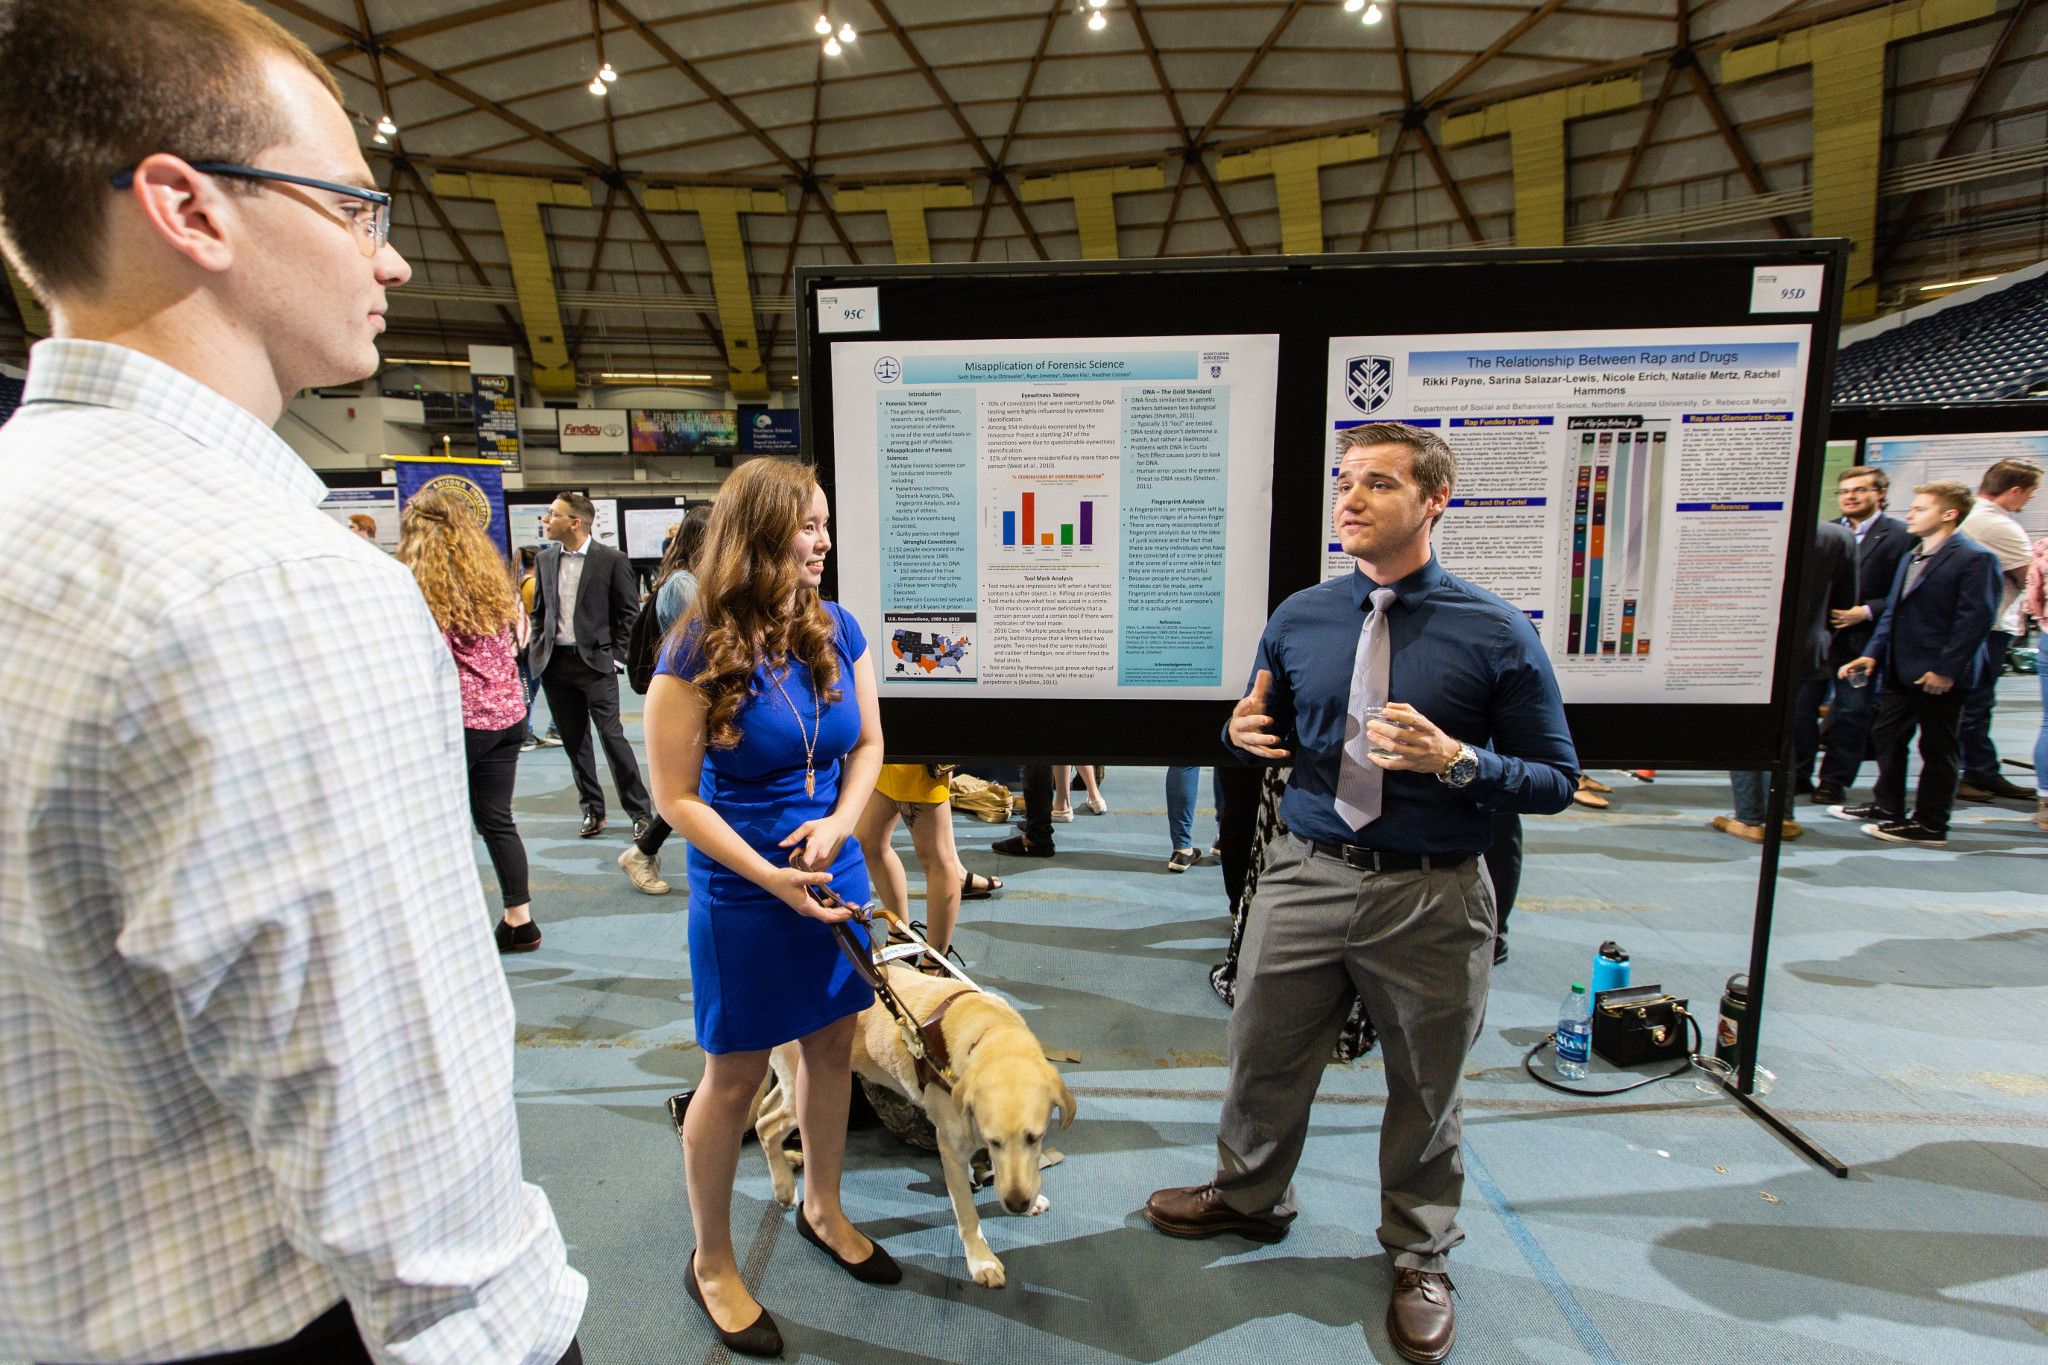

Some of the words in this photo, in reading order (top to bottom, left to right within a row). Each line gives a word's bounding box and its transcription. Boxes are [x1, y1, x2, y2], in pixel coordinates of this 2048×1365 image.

[1781, 288, 1806, 299] 95D
[844, 309, 865, 320] 95C
[1467, 357, 1491, 369] The
[1496, 355, 1575, 369] Relationship
[1578, 354, 1636, 366] Between
[1641, 352, 1667, 366] Rap
[1671, 352, 1695, 364] and
[1700, 351, 1738, 365] Drugs
[966, 362, 1033, 372] Misapplication
[1036, 361, 1045, 370] of
[1048, 360, 1087, 370] Forensic
[1089, 360, 1125, 369] Science
[1422, 377, 1448, 386] Rikki
[1451, 377, 1486, 388] Payne,
[1489, 376, 1521, 385] Sarina
[1524, 375, 1599, 384] Salazar-Lewis,
[1603, 373, 1635, 382] Nicole
[1638, 372, 1668, 382] Erich,
[1672, 372, 1707, 381] Natalie
[1710, 371, 1741, 380] Mertz,
[1744, 370, 1781, 379] Rachel
[1574, 386, 1626, 396] Hammons
[1413, 404, 1458, 413] Department
[1470, 403, 1494, 411] Social
[1495, 403, 1510, 411] and
[1513, 402, 1554, 410] Behavioral
[1627, 400, 1657, 408] Arizona
[1702, 399, 1714, 407] Dr.
[1716, 398, 1751, 406] Rebecca
[1464, 419, 1478, 427] Rap
[1518, 418, 1540, 426] Drugs
[1690, 415, 1704, 423] Rap
[563, 424, 602, 436] Findlay
[432, 479, 467, 489] ARIZONA
